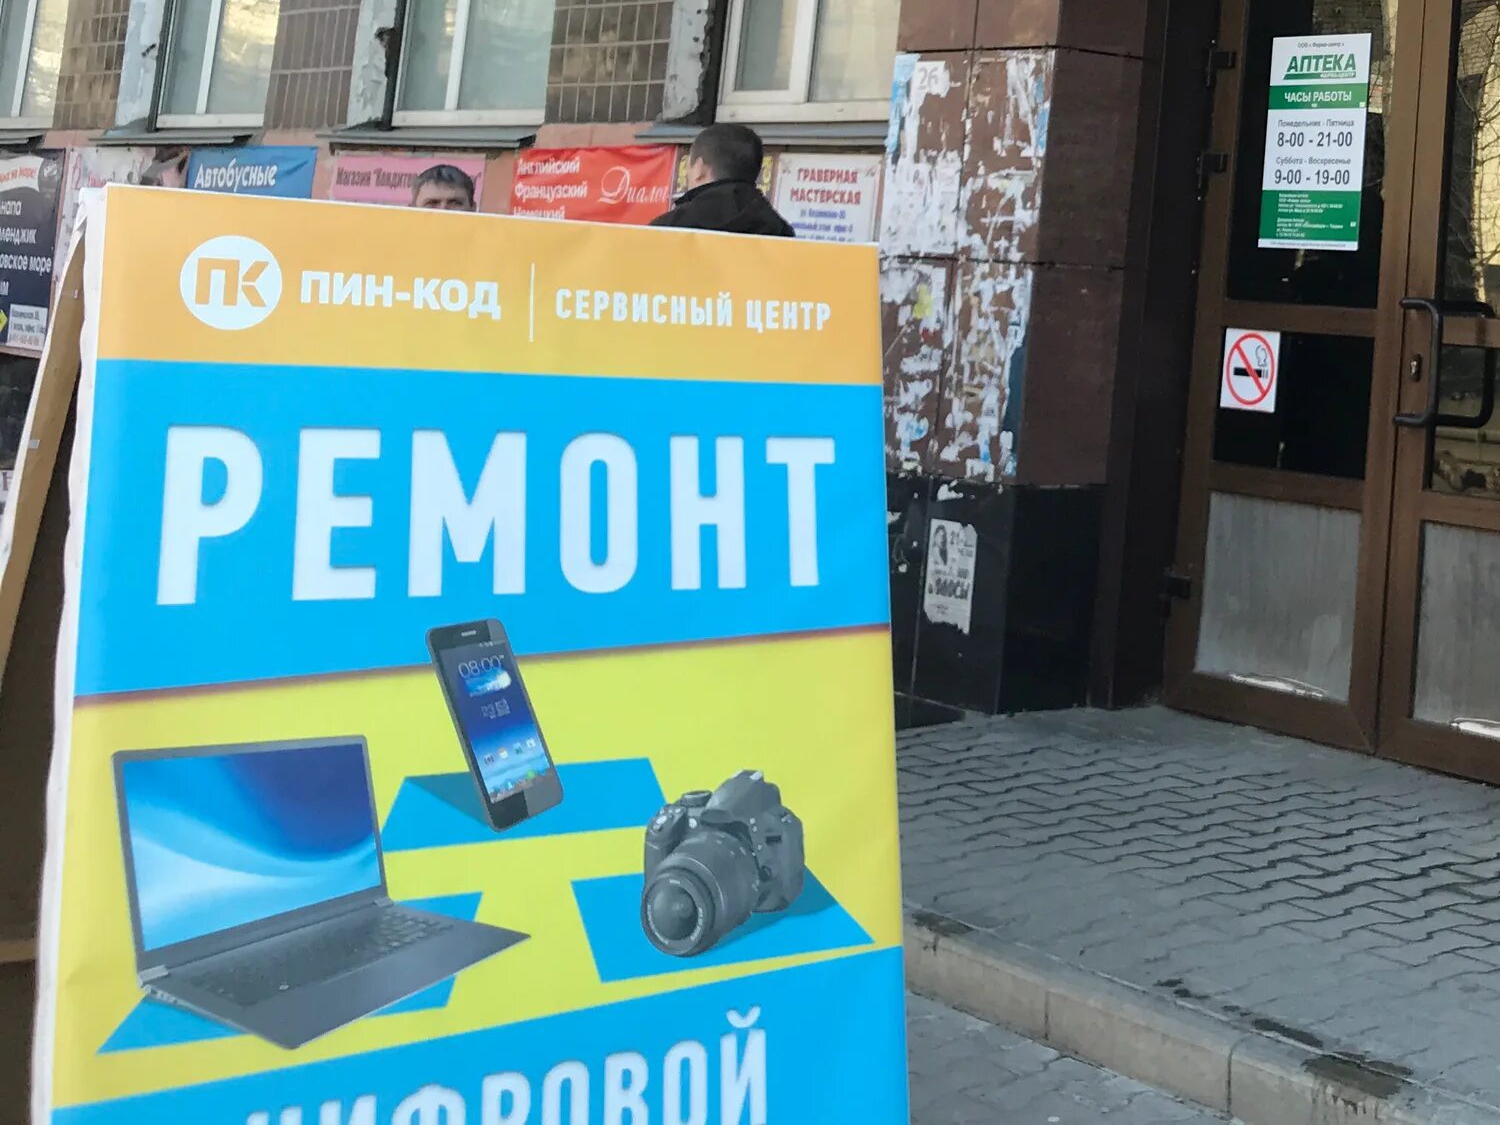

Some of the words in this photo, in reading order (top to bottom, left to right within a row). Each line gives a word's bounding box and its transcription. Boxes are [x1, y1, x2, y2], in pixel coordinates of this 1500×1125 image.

[1286, 53, 1356, 72] АПТЕКА
[1284, 91, 1311, 102] ЧАСЫ
[1313, 90, 1352, 101] РАБОТЫ
[1278, 119, 1321, 127] Понедельник
[1326, 118, 1354, 127] Пятница
[1277, 131, 1304, 147] 8-00
[1316, 131, 1353, 147] 21-00
[517, 155, 580, 176] Английский
[1276, 156, 1303, 166] Суббота
[1308, 156, 1351, 165] Воскресенье
[193, 157, 277, 193] Автобусные
[797, 167, 858, 184] ГРАВЕРНАЯ
[1274, 169, 1302, 184] 9-00
[1315, 169, 1350, 185] 19-00
[515, 180, 588, 203] Французский
[790, 187, 861, 205] МАСТЕРСКАЯ
[0, 200, 21, 215] напа
[0, 227, 37, 245] ленджик
[0, 253, 28, 270] овское
[29, 255, 52, 276] море
[300, 270, 503, 320] ПИН-КОД
[556, 287, 733, 327] СЕРВИСНЫЙ
[746, 298, 832, 334] ЦЕНТР
[156, 425, 836, 606] РЕМОНТ
[458, 655, 502, 679] 08:00
[245, 1005, 767, 1125] ФРОВОЙ
